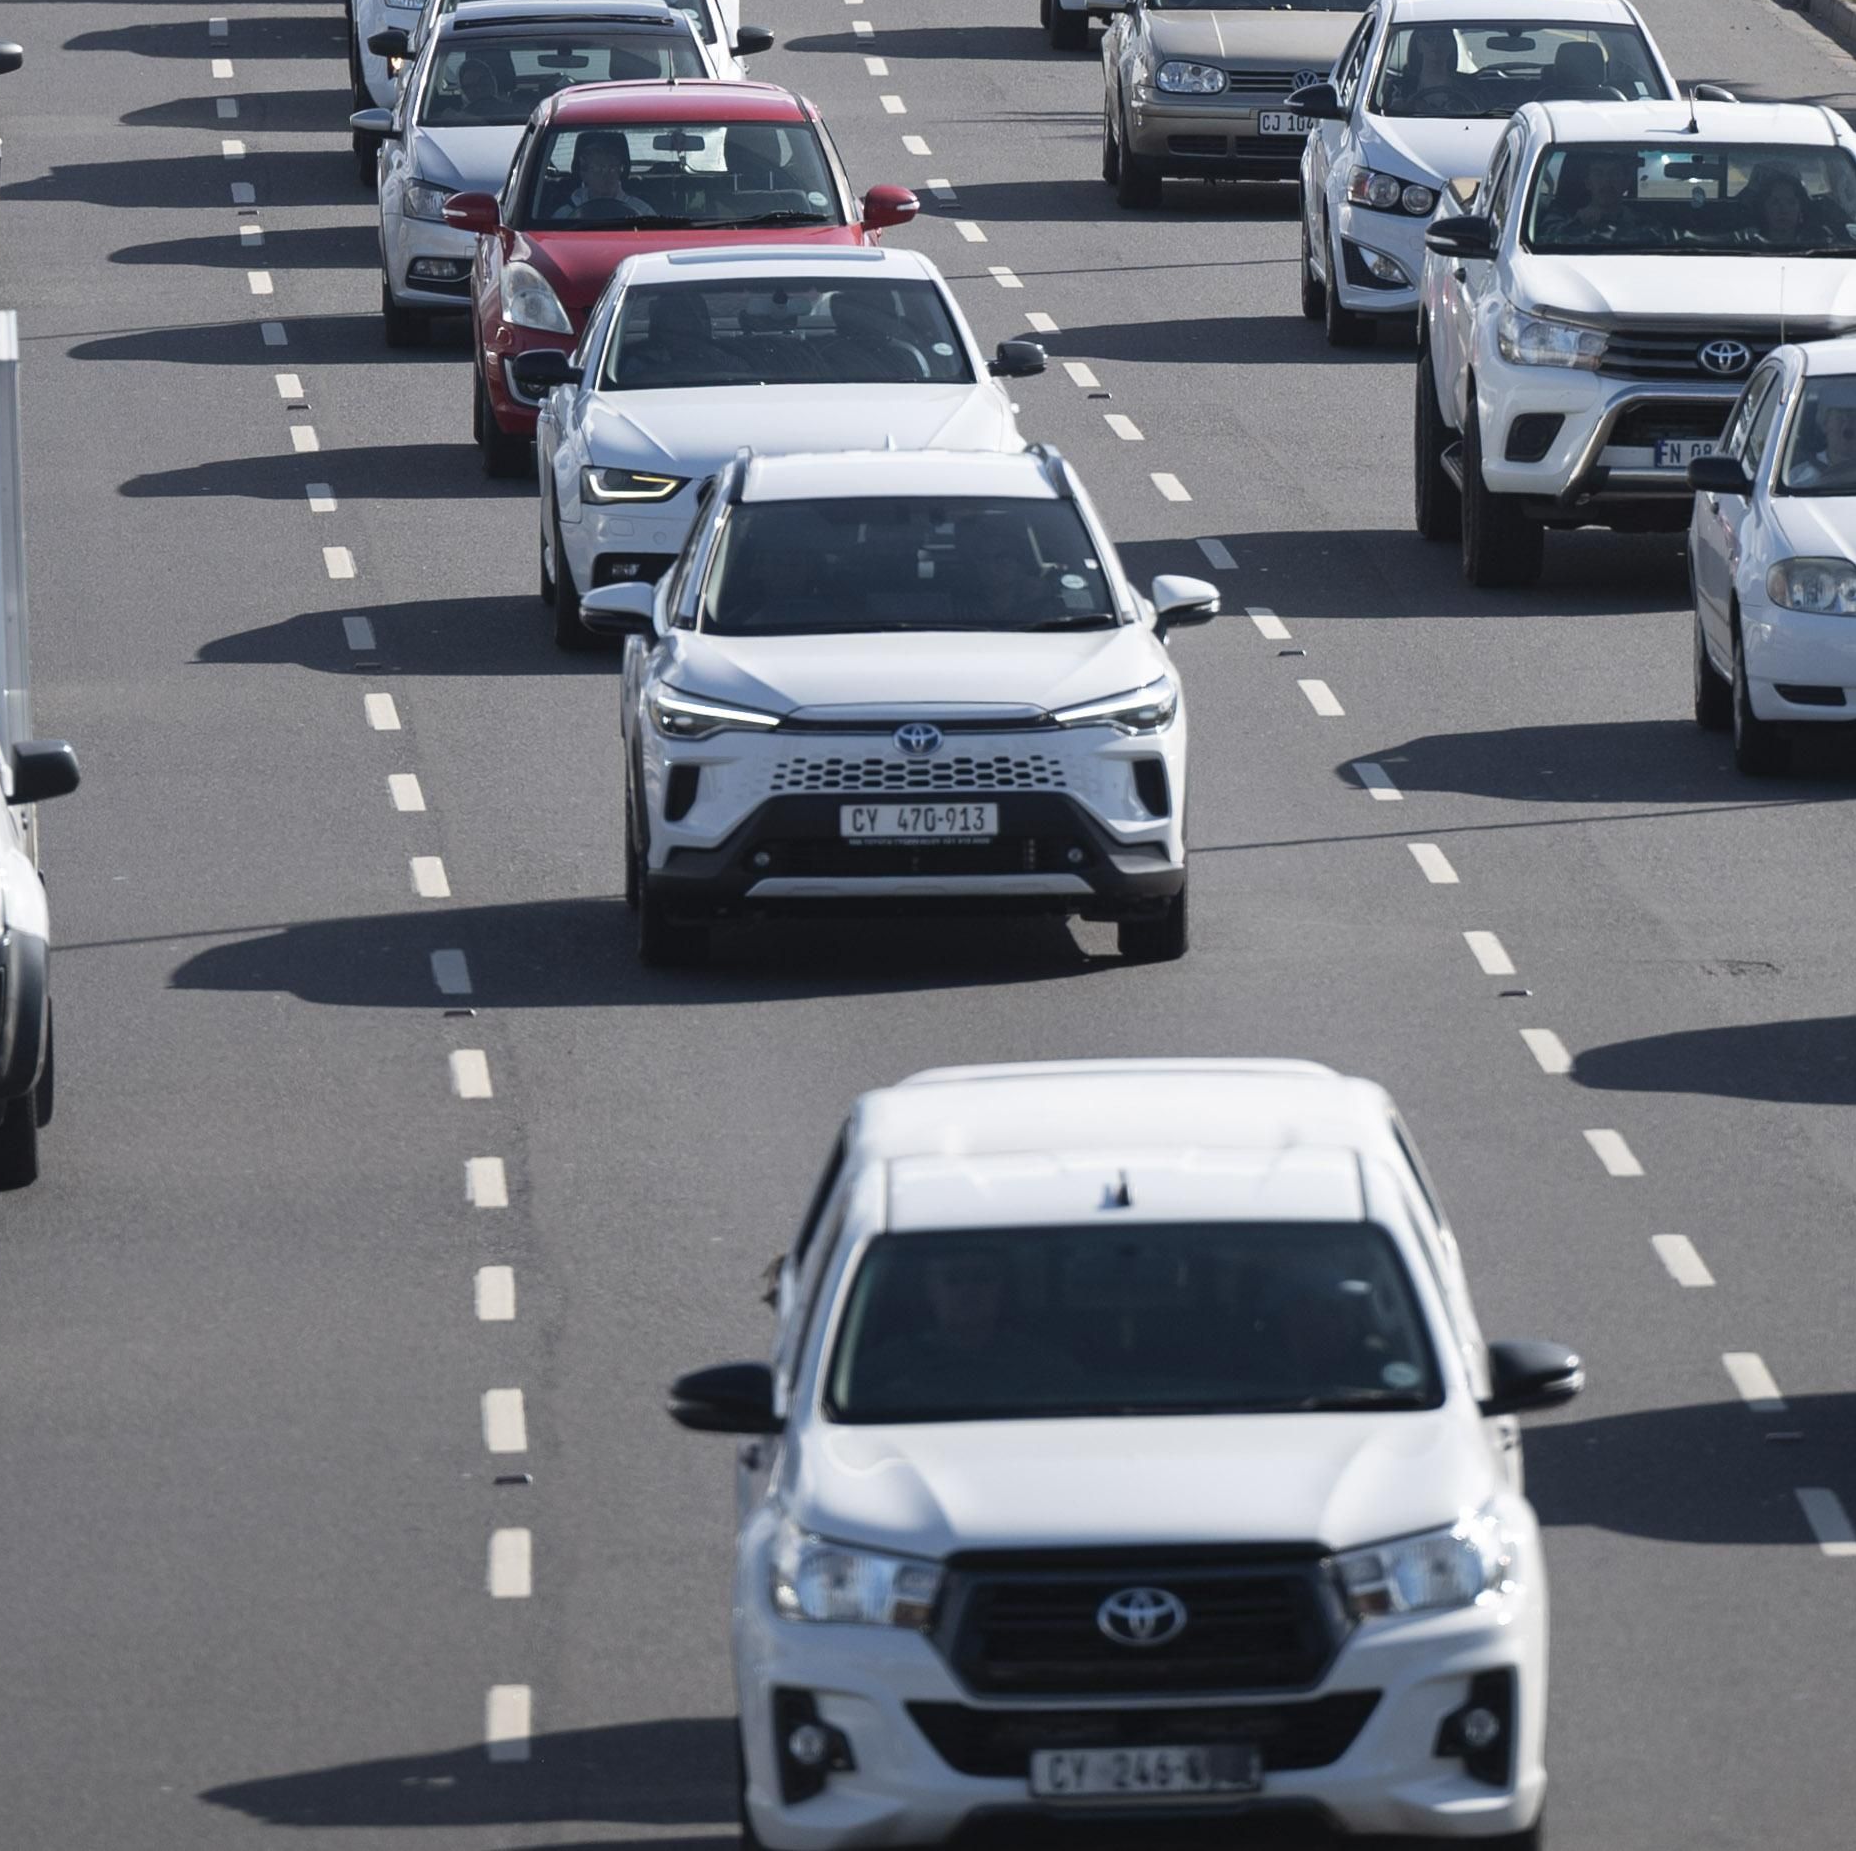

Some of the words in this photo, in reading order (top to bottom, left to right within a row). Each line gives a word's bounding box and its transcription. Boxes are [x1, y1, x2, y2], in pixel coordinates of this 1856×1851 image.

[1262, 114, 1281, 130] CJ
[851, 807, 879, 832] CY
[897, 806, 986, 832] 470-913
